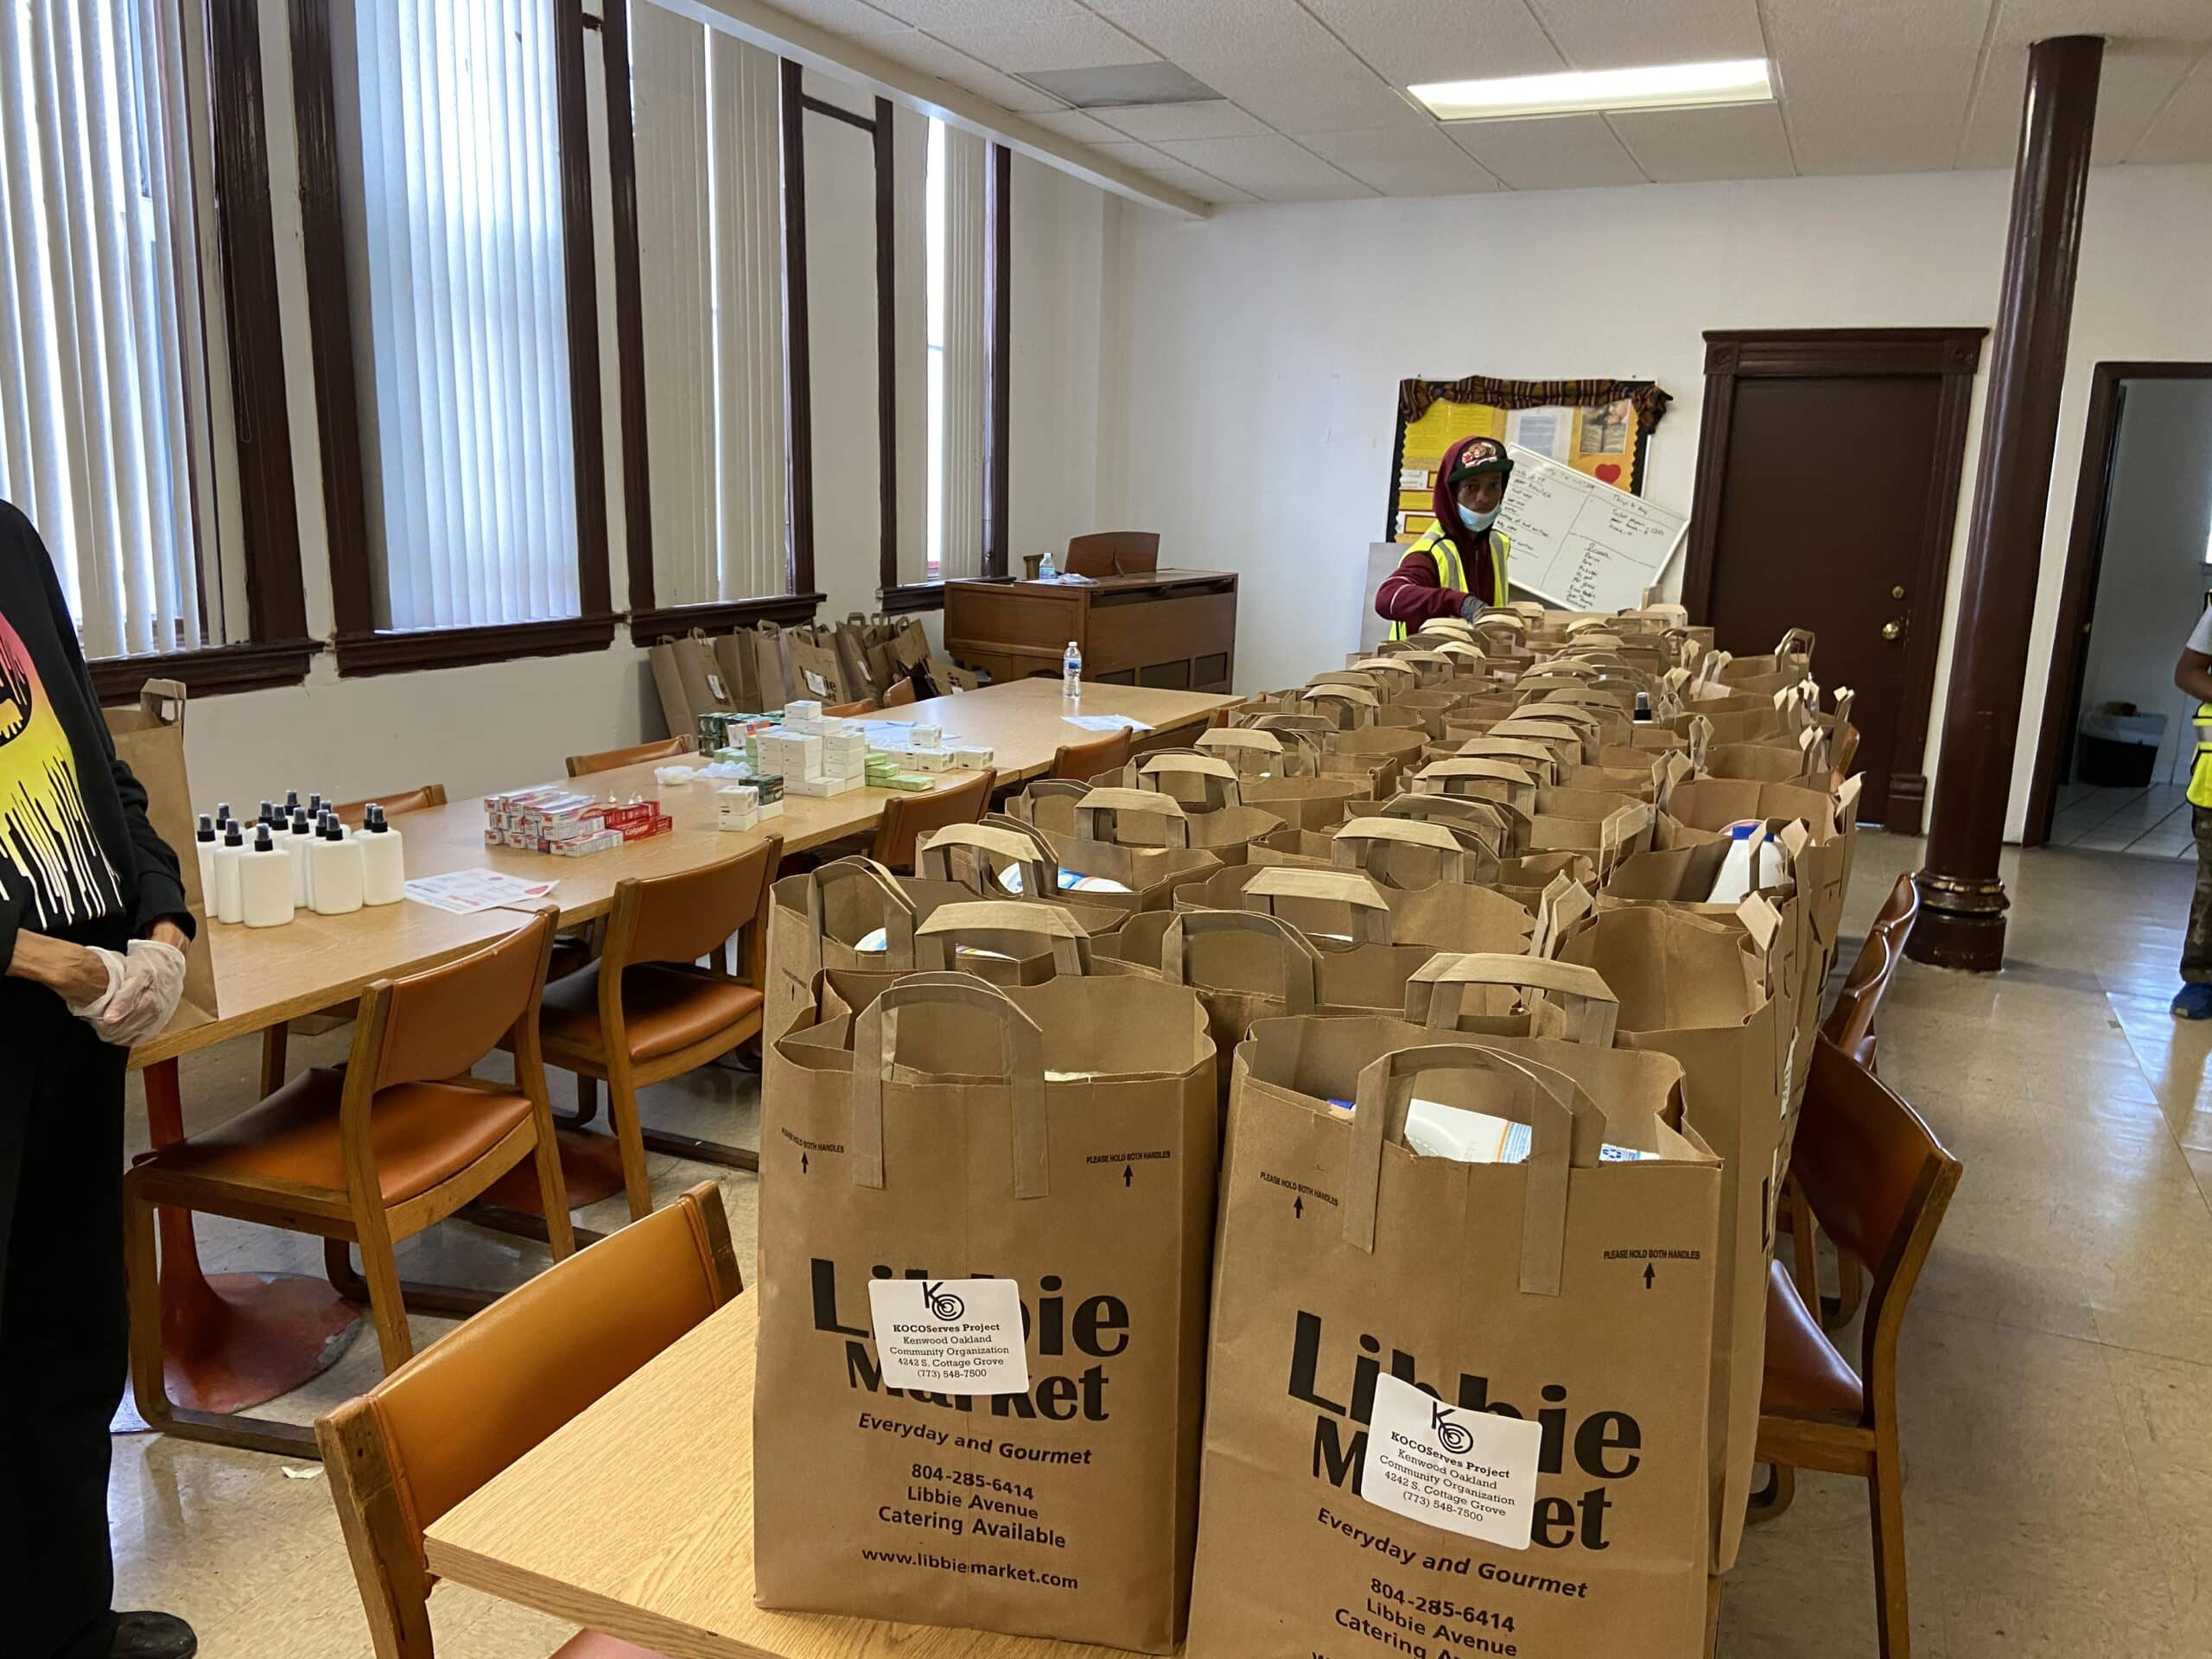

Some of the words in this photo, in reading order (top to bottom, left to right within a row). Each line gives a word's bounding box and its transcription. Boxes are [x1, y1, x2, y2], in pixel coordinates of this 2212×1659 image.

[803, 1140, 817, 1151] BOTH
[817, 1143, 844, 1154] HANDLES
[1086, 1154, 1109, 1164] PLEASE
[1109, 1154, 1126, 1162] HOLD
[1126, 1152, 1142, 1161] BOTH
[1143, 1150, 1171, 1160] HANDLES
[1260, 1171, 1281, 1185] PLEASE
[1281, 1179, 1297, 1192] HOLD
[1297, 1184, 1313, 1197] BOTH
[1313, 1190, 1338, 1207] HANDLES
[1604, 1249, 1629, 1260] PLEASE
[1629, 1249, 1648, 1259] HOLD
[1648, 1249, 1668, 1259] BOTH
[1668, 1249, 1700, 1260] HANDLES
[810, 1257, 1129, 1357] Lie
[893, 1325, 961, 1333] KOCOServes
[963, 1323, 1001, 1333] Project
[903, 1336, 949, 1345] Kenwood
[950, 1335, 992, 1344] Oakland
[889, 1346, 944, 1357] Community
[946, 1346, 1009, 1357] Organization
[898, 1357, 919, 1367] 4242
[921, 1358, 931, 1367] S.
[932, 1358, 971, 1369] Cottage
[973, 1357, 1004, 1366] Grove
[917, 1370, 941, 1379] (773)
[943, 1369, 987, 1378] 548-7500
[858, 1412, 949, 1446] Everyday
[954, 1435, 993, 1453] and
[999, 1442, 1092, 1465] Gourmet
[1390, 1431, 1463, 1468] KOCOServes
[1465, 1461, 1510, 1479] Project
[912, 1463, 1034, 1501] 804-285-6414
[1313, 1415, 1612, 1551] Met
[1379, 1454, 1441, 1485] Community
[1443, 1478, 1516, 1506] Organization
[1397, 1448, 1447, 1475] Kenwood
[1450, 1469, 1497, 1490] Oakland
[907, 1485, 963, 1508] Libbie
[968, 1494, 1039, 1519] Avenue
[1384, 1470, 1409, 1488] 4242
[1411, 1481, 1421, 1491] S.
[1424, 1485, 1467, 1506] Cottage
[1471, 1499, 1506, 1517] Grove
[1402, 1491, 1431, 1508] (773)
[1433, 1499, 1484, 1522] 548-7500
[878, 1506, 963, 1535] Catering
[971, 1518, 1066, 1548] Available
[861, 1548, 1078, 1589] www.libbiemarket.com
[1318, 1507, 1416, 1566] Everyday
[1422, 1555, 1471, 1575] and
[1478, 1562, 1589, 1599] Gourmet
[1370, 1578, 1515, 1632] 804-285-6414
[1335, 1608, 1427, 1659] Catering
[1366, 1598, 1426, 1635] Libbie
[1432, 1624, 1518, 1656] Avenue
